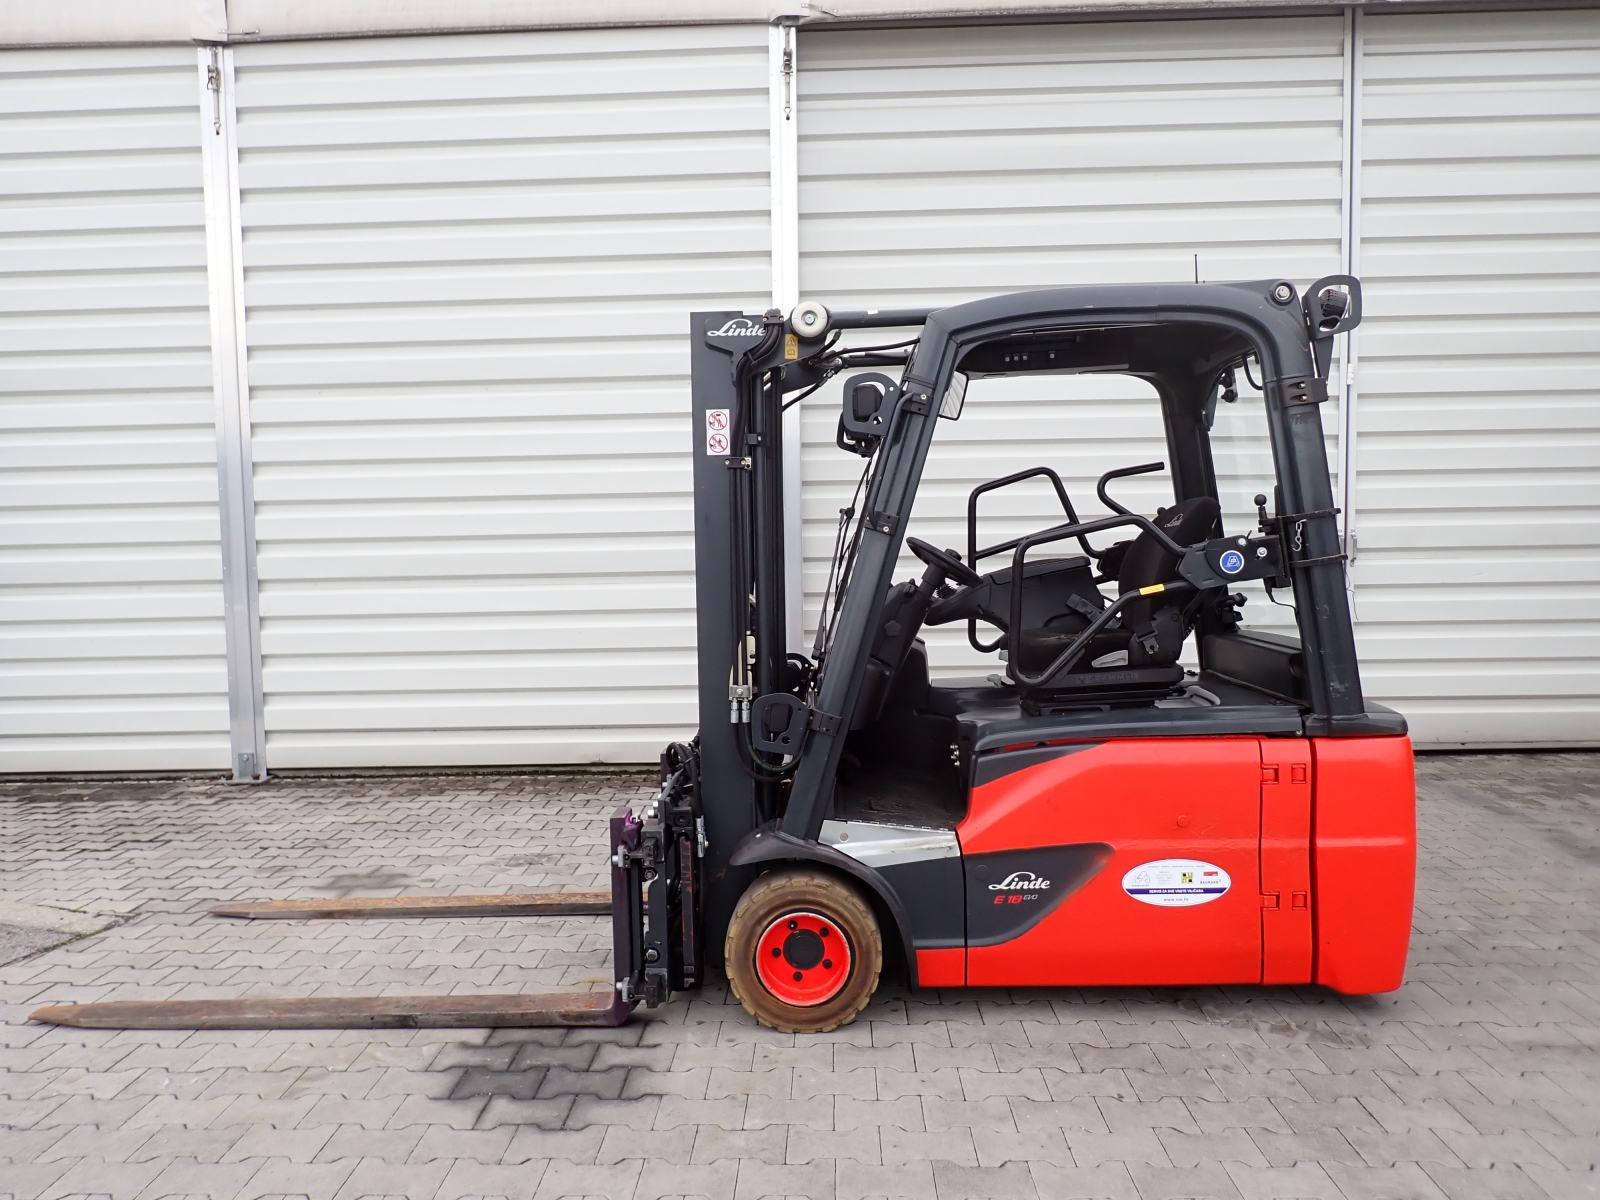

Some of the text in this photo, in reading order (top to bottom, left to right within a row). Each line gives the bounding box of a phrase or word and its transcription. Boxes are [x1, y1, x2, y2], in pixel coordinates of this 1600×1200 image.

[707, 318, 767, 337] Linde
[988, 871, 1051, 890] Linde
[993, 895, 1006, 905] E
